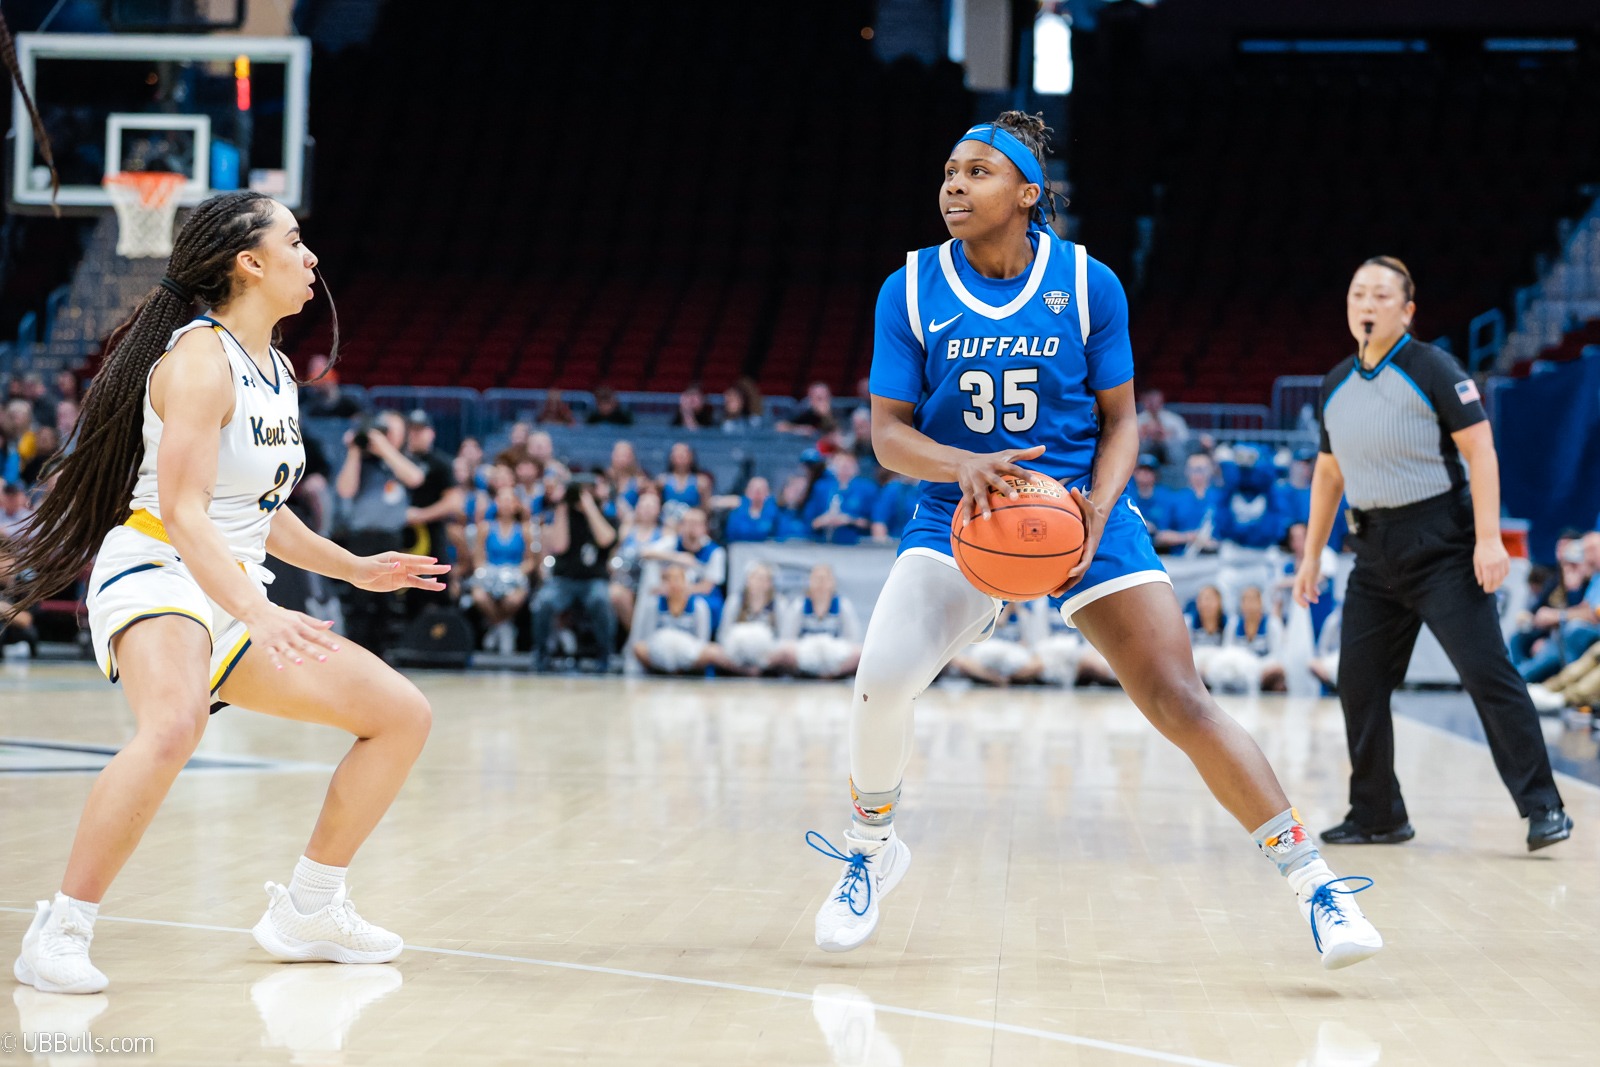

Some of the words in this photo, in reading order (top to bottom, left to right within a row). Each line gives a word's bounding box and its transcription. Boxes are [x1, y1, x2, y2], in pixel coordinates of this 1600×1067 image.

[1044, 297, 1069, 305] MAC
[946, 336, 1060, 360] BUFFALO
[959, 366, 1039, 434] 35
[250, 416, 287, 446] Kent
